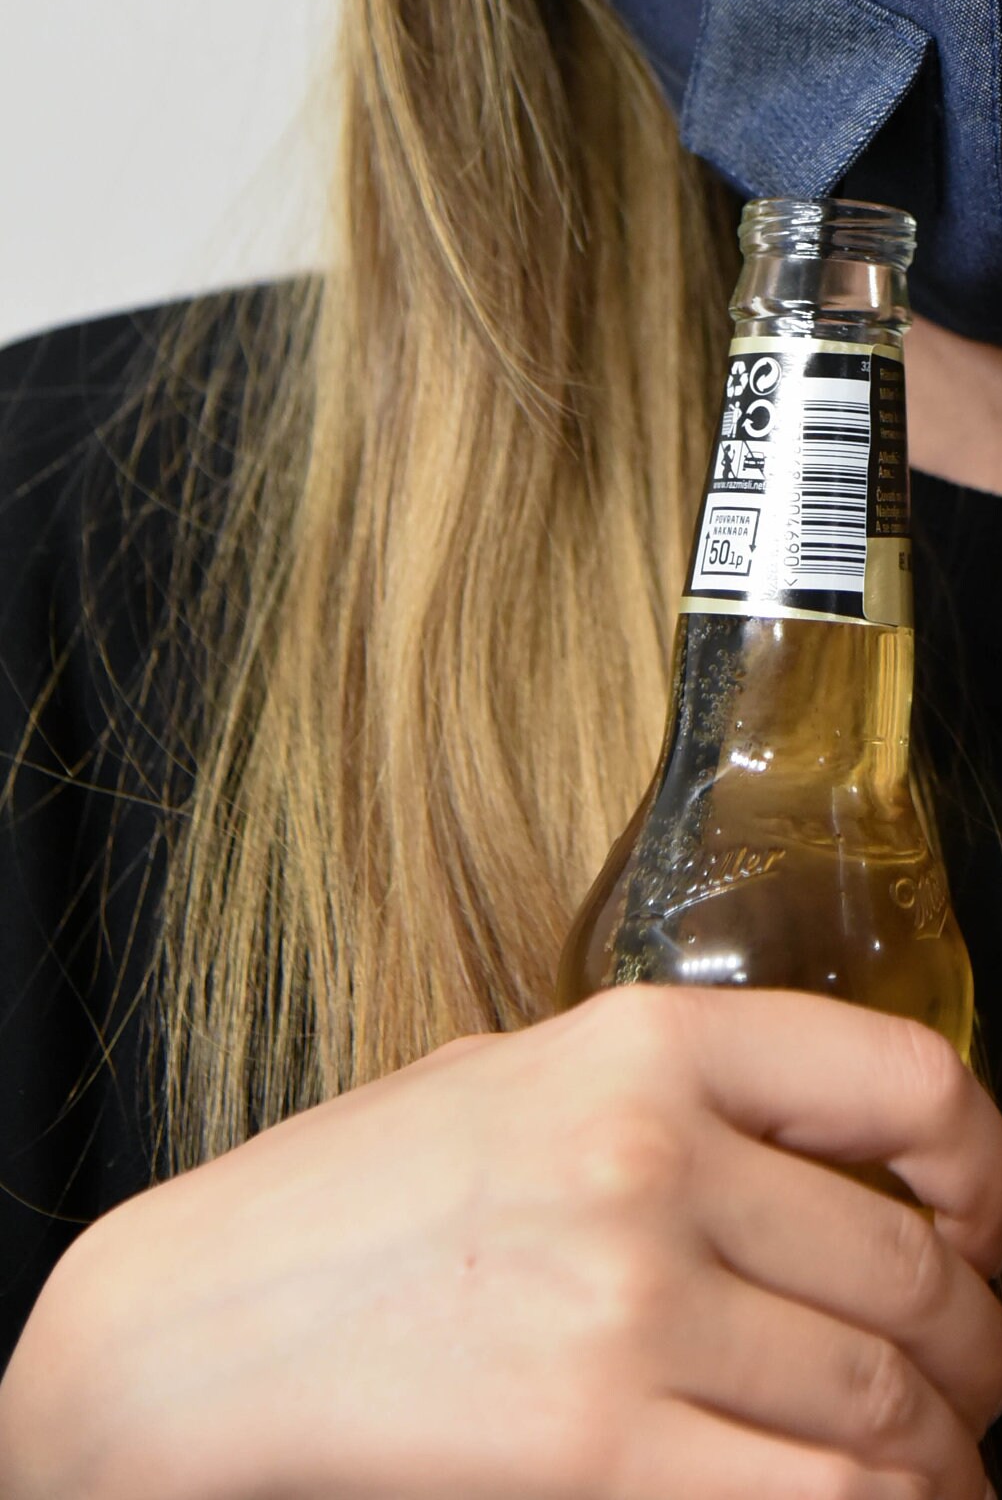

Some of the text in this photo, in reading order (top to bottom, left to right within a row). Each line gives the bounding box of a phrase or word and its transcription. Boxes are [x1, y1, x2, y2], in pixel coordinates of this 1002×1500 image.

[713, 480, 766, 491] www.razmisli.net
[715, 515, 751, 525] POVRATNA
[713, 526, 749, 536] NAKNADA
